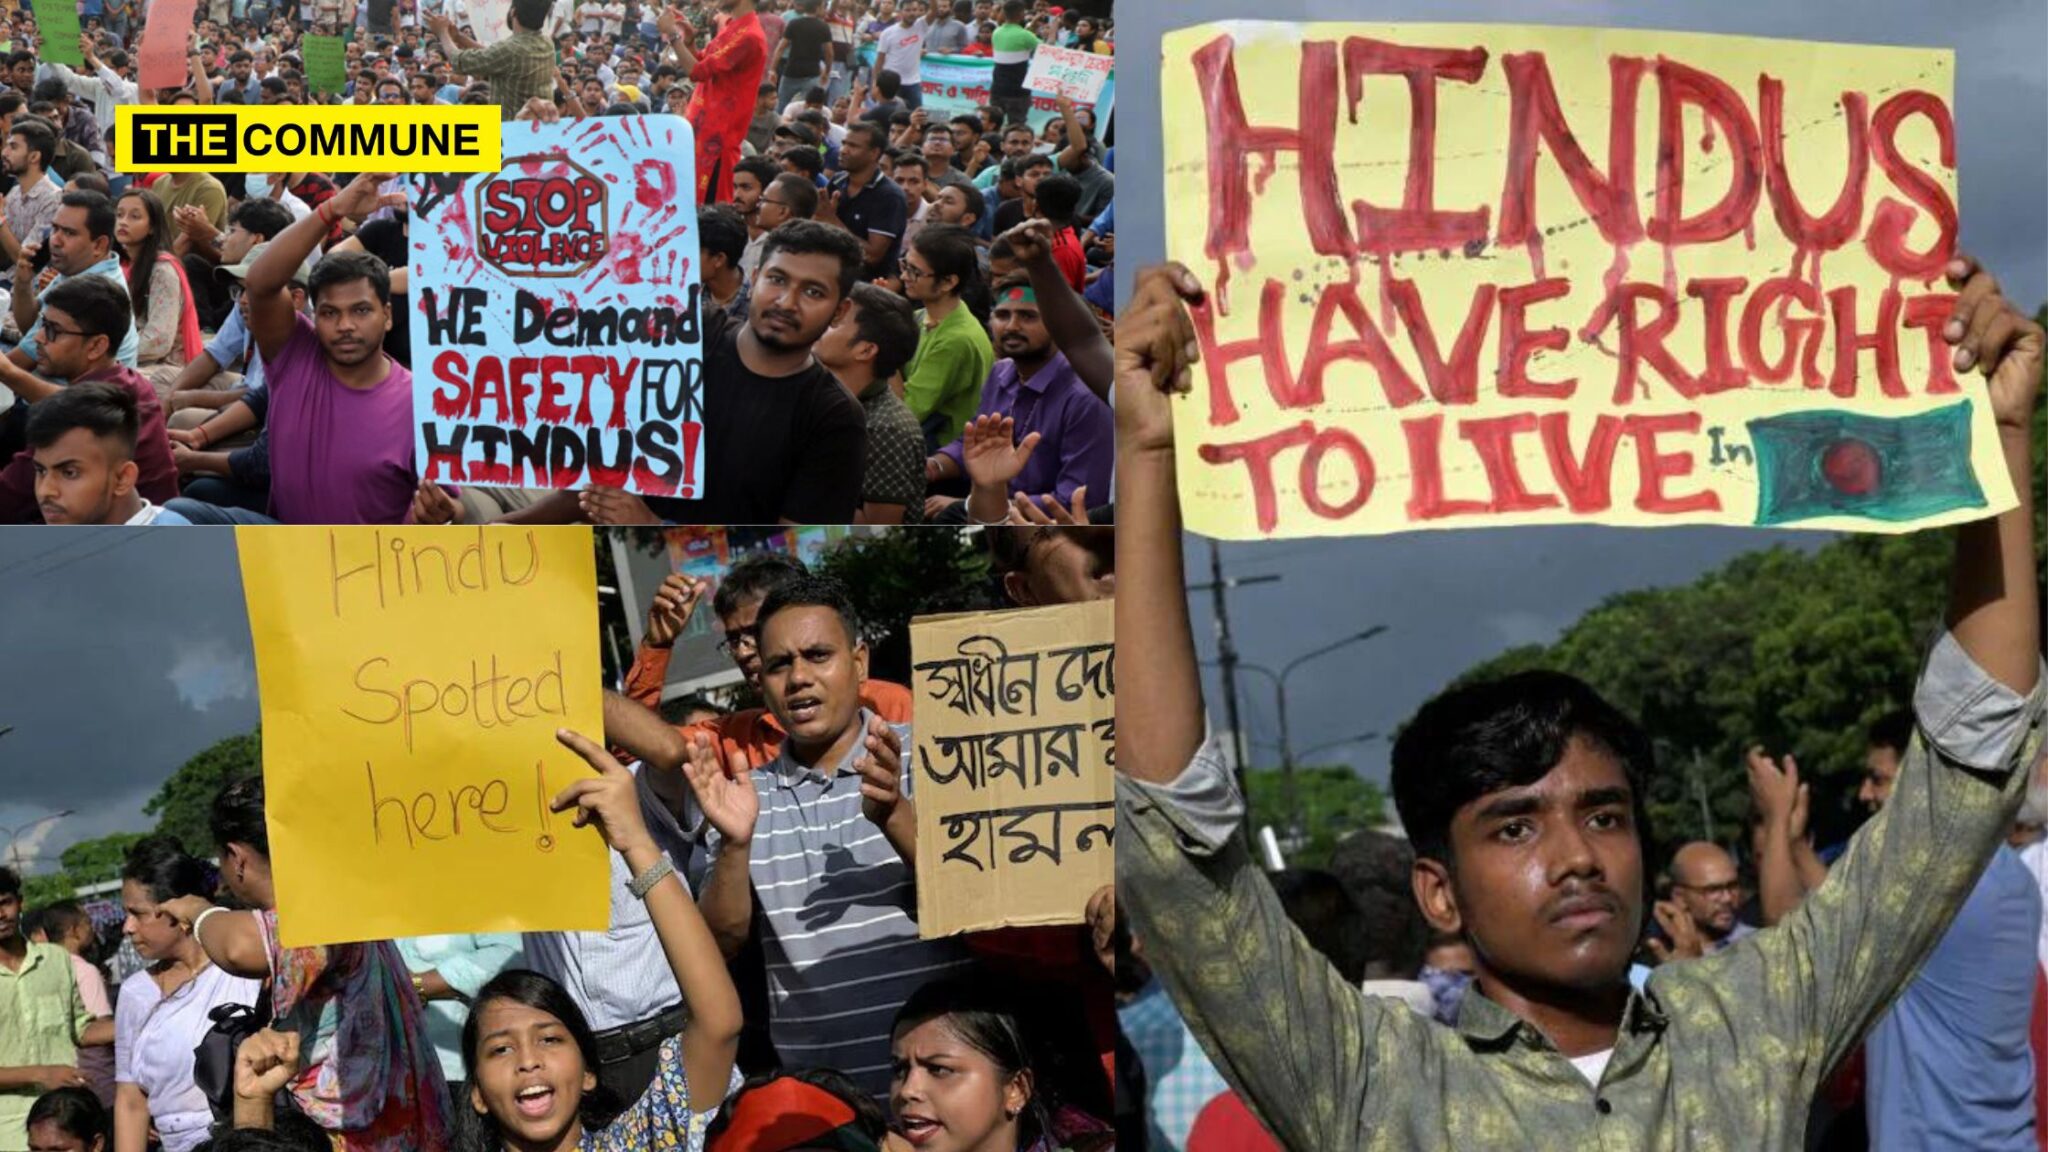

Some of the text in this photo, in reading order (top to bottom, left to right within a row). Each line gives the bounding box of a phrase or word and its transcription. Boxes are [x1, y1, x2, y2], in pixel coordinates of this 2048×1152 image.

[1194, 34, 1960, 280] HINDUS
[484, 176, 602, 236] STOP
[481, 232, 605, 266] VIOLENCE
[513, 283, 701, 347] Demand
[1192, 276, 1962, 425] HAVE RIGHT
[432, 350, 704, 430] SAFETY FOR
[422, 420, 703, 498] HINDUS!
[1199, 412, 1754, 532] TO LIVE In
[330, 526, 541, 617] Hindu
[340, 650, 567, 755] Spotted
[919, 723, 1087, 791] আমার
